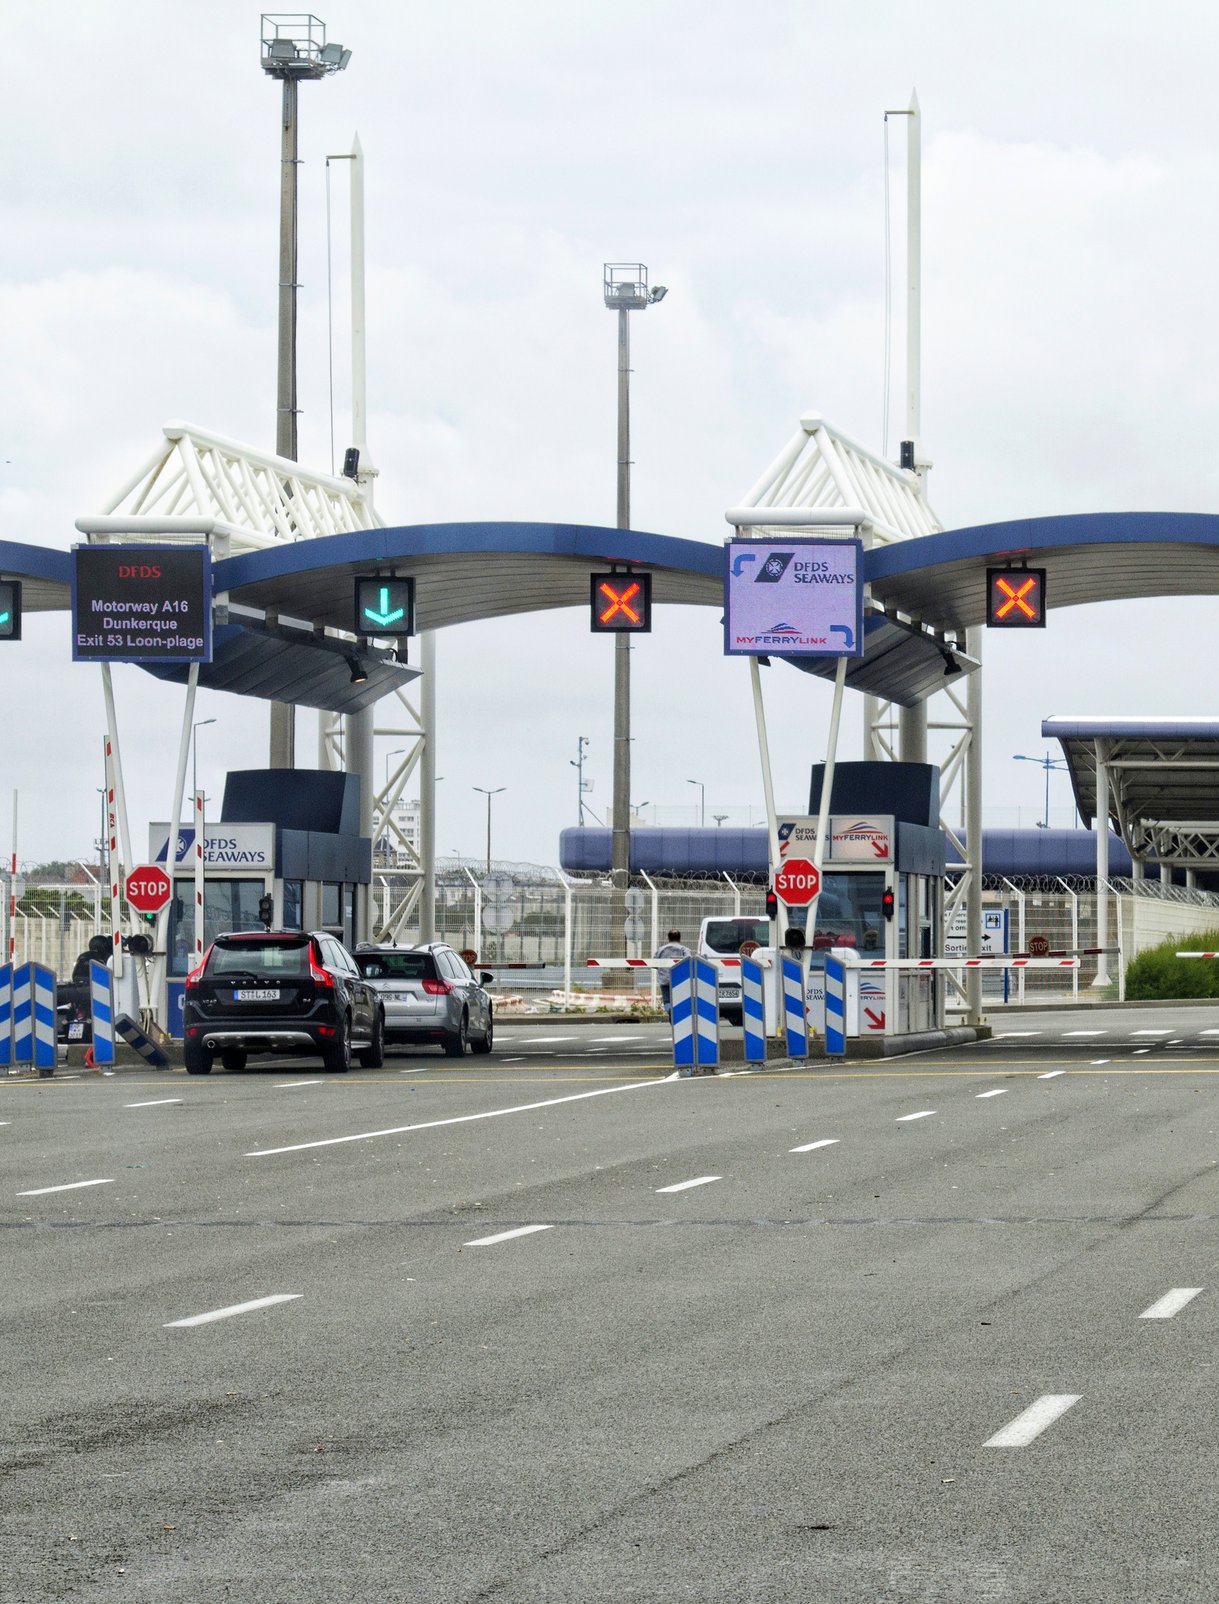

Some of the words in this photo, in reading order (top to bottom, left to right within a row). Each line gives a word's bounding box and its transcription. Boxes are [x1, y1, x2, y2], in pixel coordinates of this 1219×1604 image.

[118, 565, 161, 578] DFDS
[793, 561, 829, 572] DFDS
[793, 573, 855, 584] SEAWAYS
[91, 600, 158, 614] Motorway
[162, 600, 189, 612] A16
[103, 617, 178, 631] Dunkerque
[77, 634, 103, 646] Exit
[107, 634, 123, 646] 53
[126, 634, 204, 649] Loon-plage
[736, 636, 827, 644] MYFERRYLINK
[129, 881, 168, 896] STOP
[778, 875, 817, 889] STOP
[944, 944, 967, 952] Sorti
[1029, 942, 1048, 952] STOP
